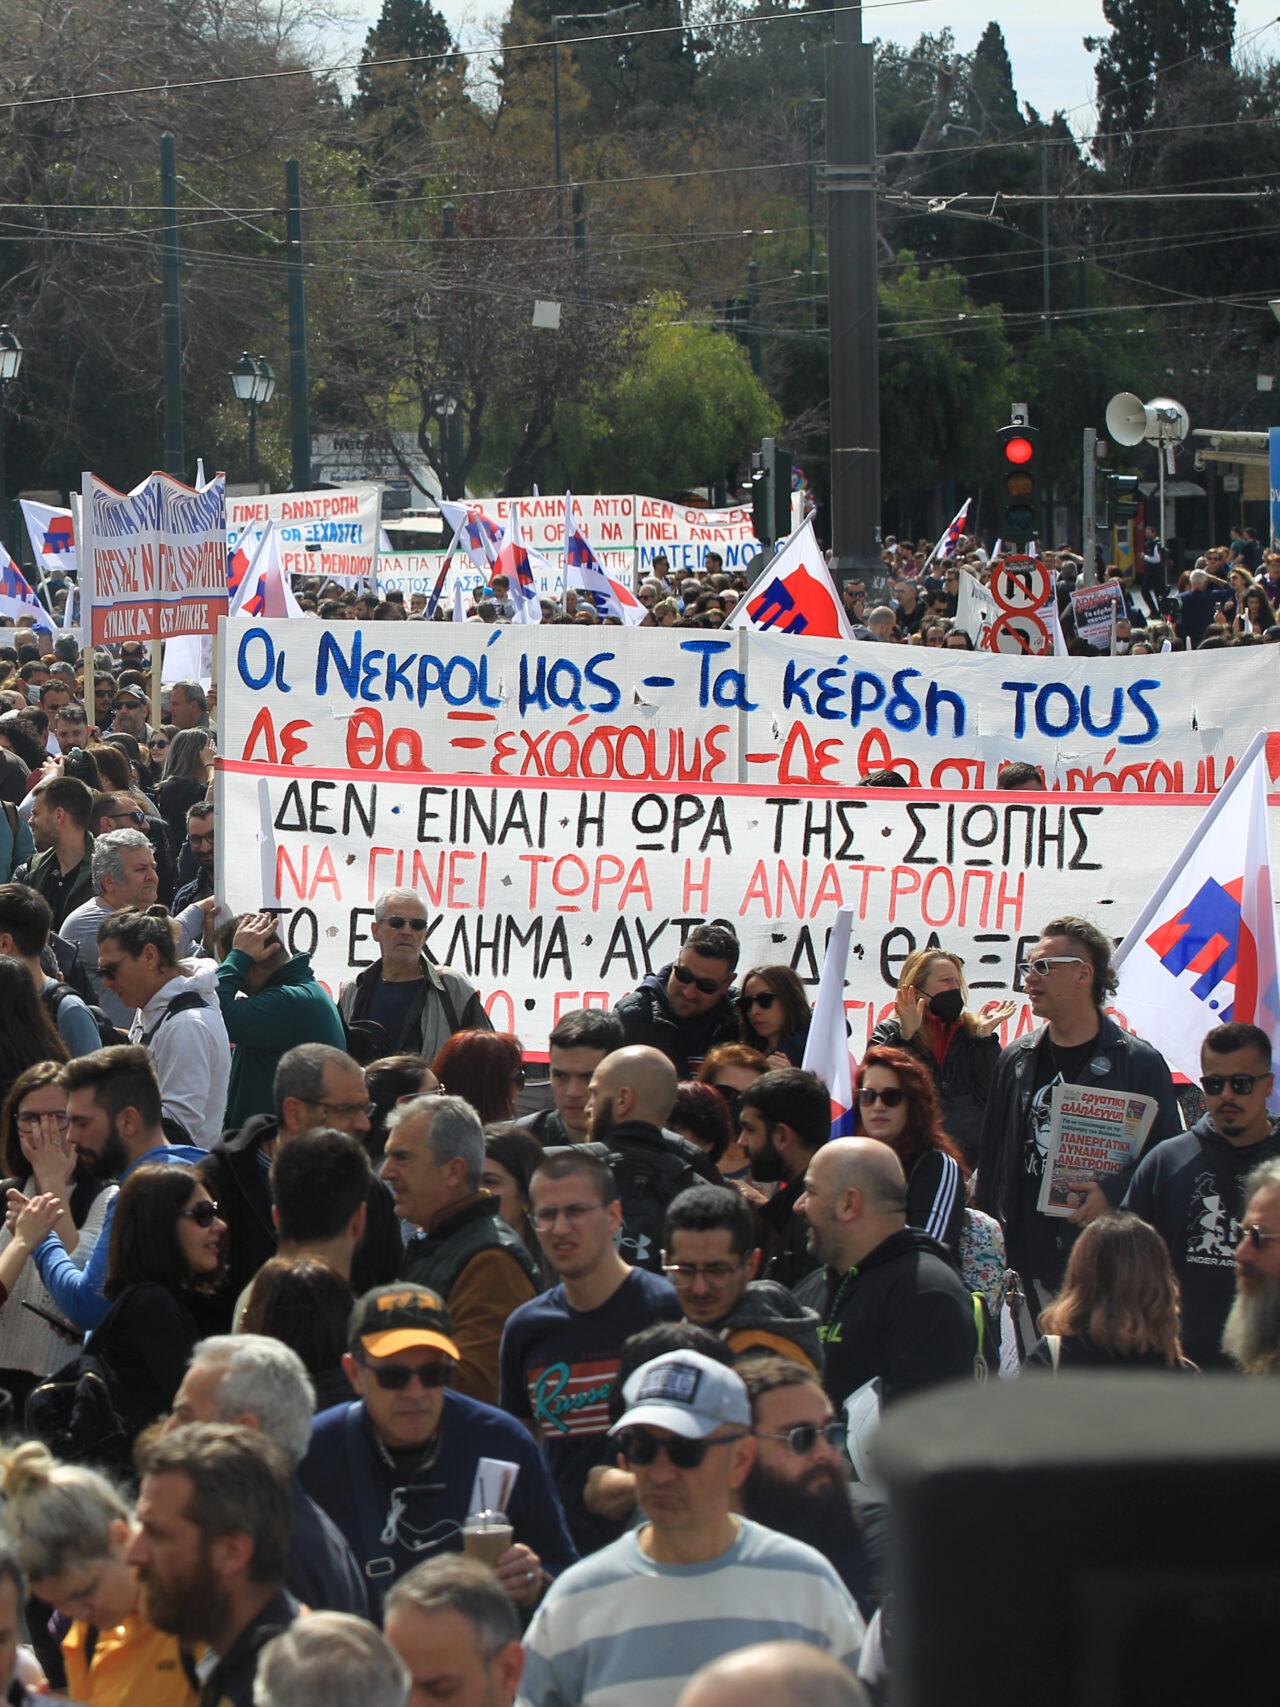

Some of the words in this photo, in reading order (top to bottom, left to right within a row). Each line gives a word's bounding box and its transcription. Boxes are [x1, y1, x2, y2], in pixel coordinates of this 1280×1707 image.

[233, 503, 269, 523] ΓΙΝΕΙ
[281, 496, 359, 520] ΑΝΑΤΡΟΠΗ
[498, 499, 583, 519] ΕΚΛΗΜΑ
[593, 498, 632, 517] ΑΥΤΟ
[641, 500, 674, 519] ΔΕΝ
[685, 510, 708, 524] ΘΑ
[716, 508, 753, 524] ΞΕΧ
[304, 521, 363, 544] ΞΕΧΑΣΤΕΙ
[544, 523, 589, 543] ΟΡΗ
[601, 523, 623, 540] ΝΑ
[634, 523, 678, 541] ΓΙΝΕΙ
[281, 553, 317, 573] ΡΕΙΣ
[321, 553, 372, 576] ΜΕΝΙΔΙΟΥ
[408, 557, 430, 572] ΓΙΑ
[237, 627, 292, 692] Οι
[315, 629, 502, 709] Νεκροί
[519, 652, 622, 719] μας
[680, 639, 759, 713] Τα
[783, 653, 967, 739] κέρδη
[241, 706, 315, 767] Δε
[778, 720, 846, 785] Δε
[274, 779, 378, 838] ΔΕΝ
[416, 786, 549, 846] ΕΙΝΑΙ
[577, 790, 605, 849] Η
[631, 793, 733, 855] ΩΡΑ
[765, 797, 868, 862] ΤΗΣ
[903, 802, 1104, 872] ΣΙΩΠΗΣ
[273, 843, 343, 902] ΝΑ
[366, 846, 488, 910] ΓΙΝΕΙ
[518, 852, 654, 914] ΤΩΡΑ
[682, 856, 714, 914] Η
[738, 858, 1025, 933] ΑΝΑΤΡΟΠΗ
[346, 906, 573, 981] ΕΚΛΗΜΑ
[1058, 1143, 1108, 1159] ΔΥΝΑΜΗ
[1061, 1132, 1131, 1153] ΠΑΝΕΡΓΑΤΙΚΗ
[1186, 1255, 1218, 1266] UNDER
